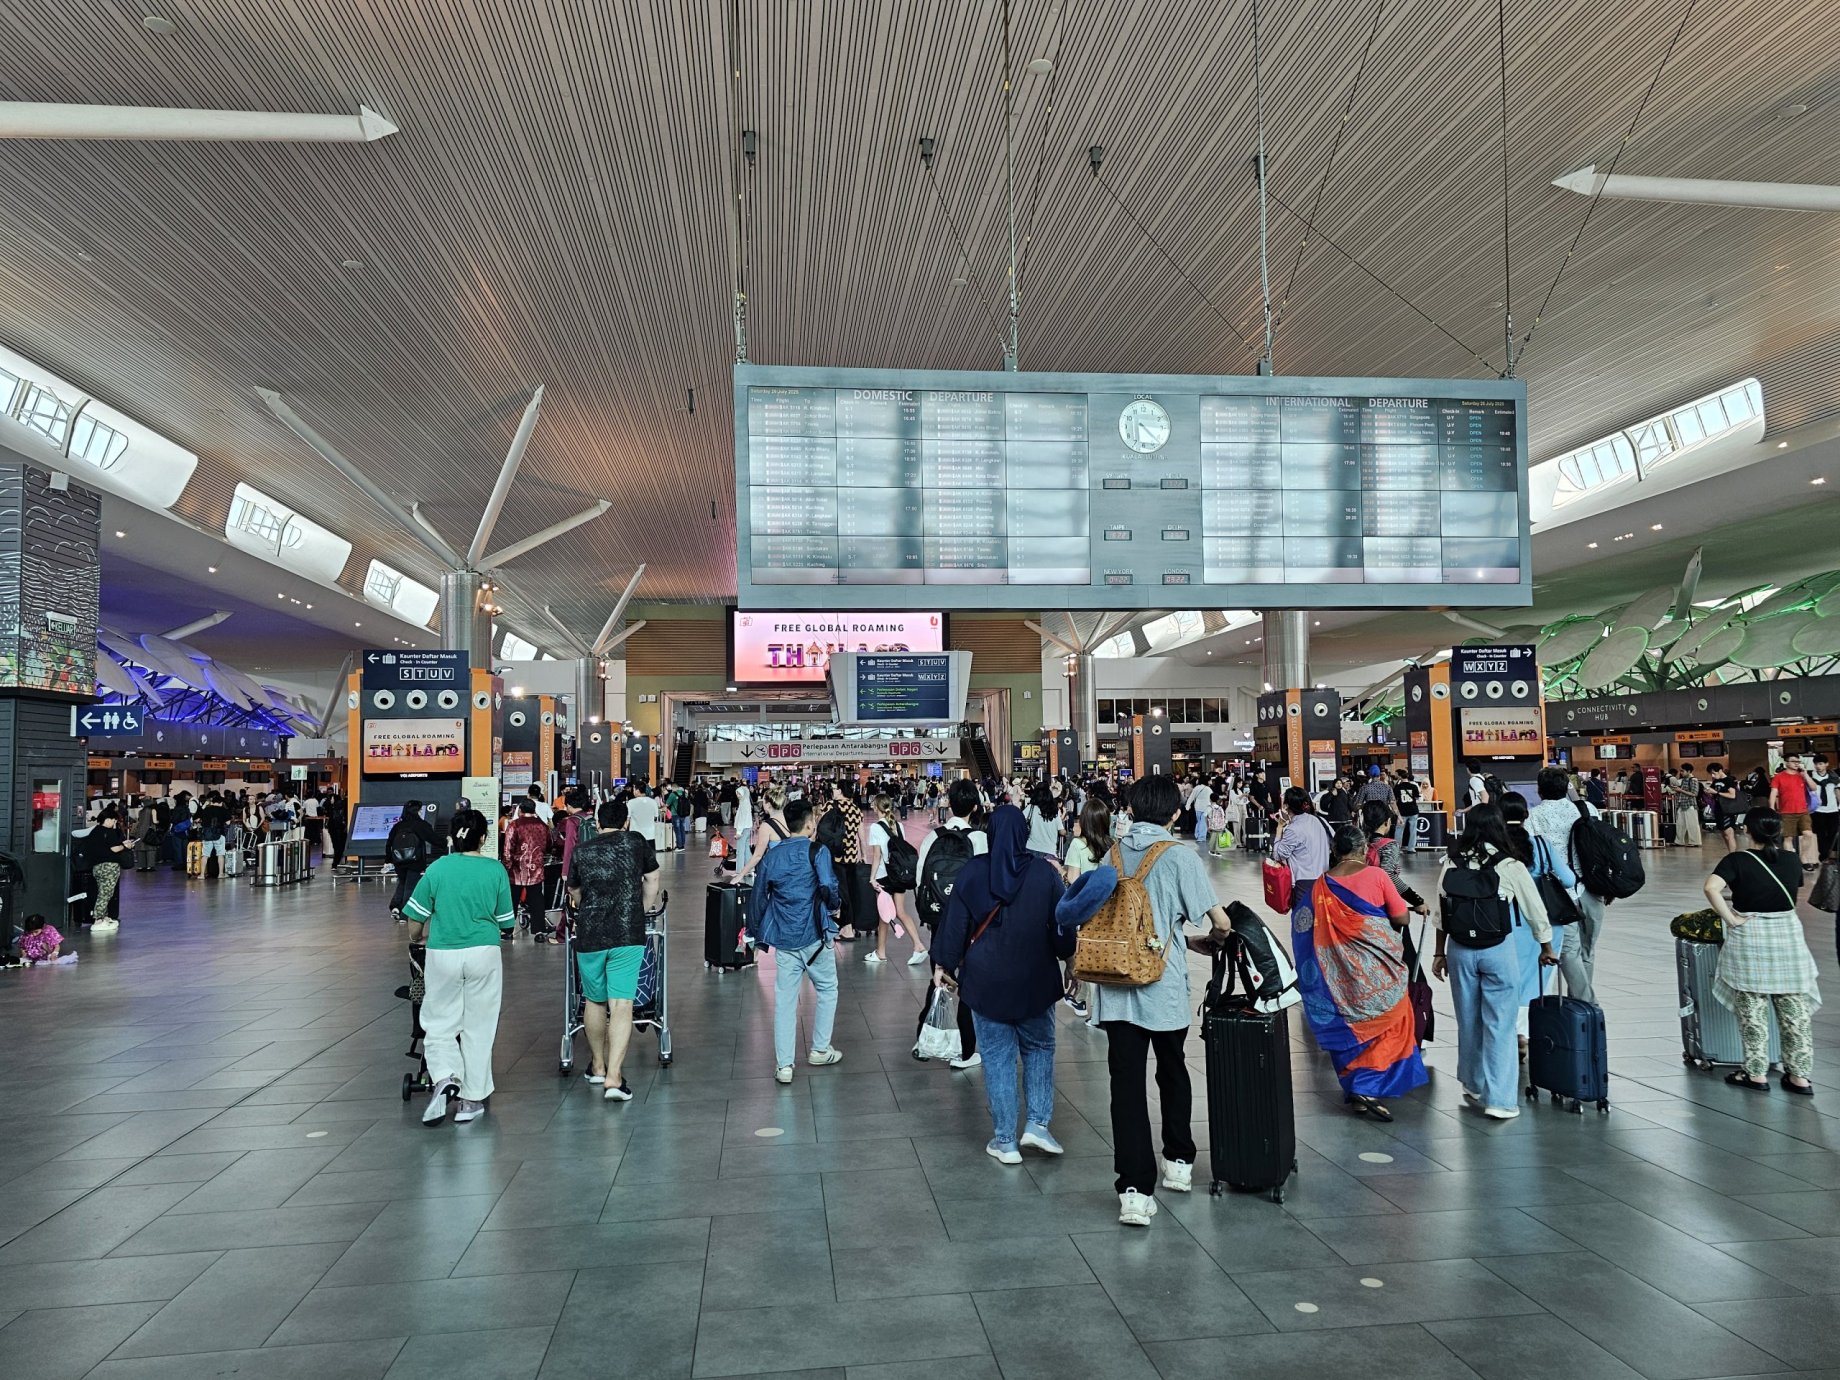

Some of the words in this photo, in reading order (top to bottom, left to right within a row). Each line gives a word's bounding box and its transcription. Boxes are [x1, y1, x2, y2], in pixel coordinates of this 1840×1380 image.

[854, 390, 912, 400] DOMESTIC
[930, 392, 994, 402] DEPARTURE
[1266, 396, 1350, 407] INTERNATIONAL
[1368, 398, 1428, 408] DEPARTURE
[56, 622, 74, 633] KELUAR
[774, 624, 800, 632] FREE
[805, 624, 848, 632] GLOBAL
[852, 624, 904, 632] ROAMING
[404, 670, 410, 678] S
[417, 670, 423, 678] T
[430, 670, 437, 678] U
[444, 670, 451, 678] V
[1577, 704, 1626, 714] CONNECTIVITY
[771, 748, 776, 756] L
[782, 748, 788, 756] P
[792, 748, 800, 756] Q
[912, 746, 919, 754] Q
